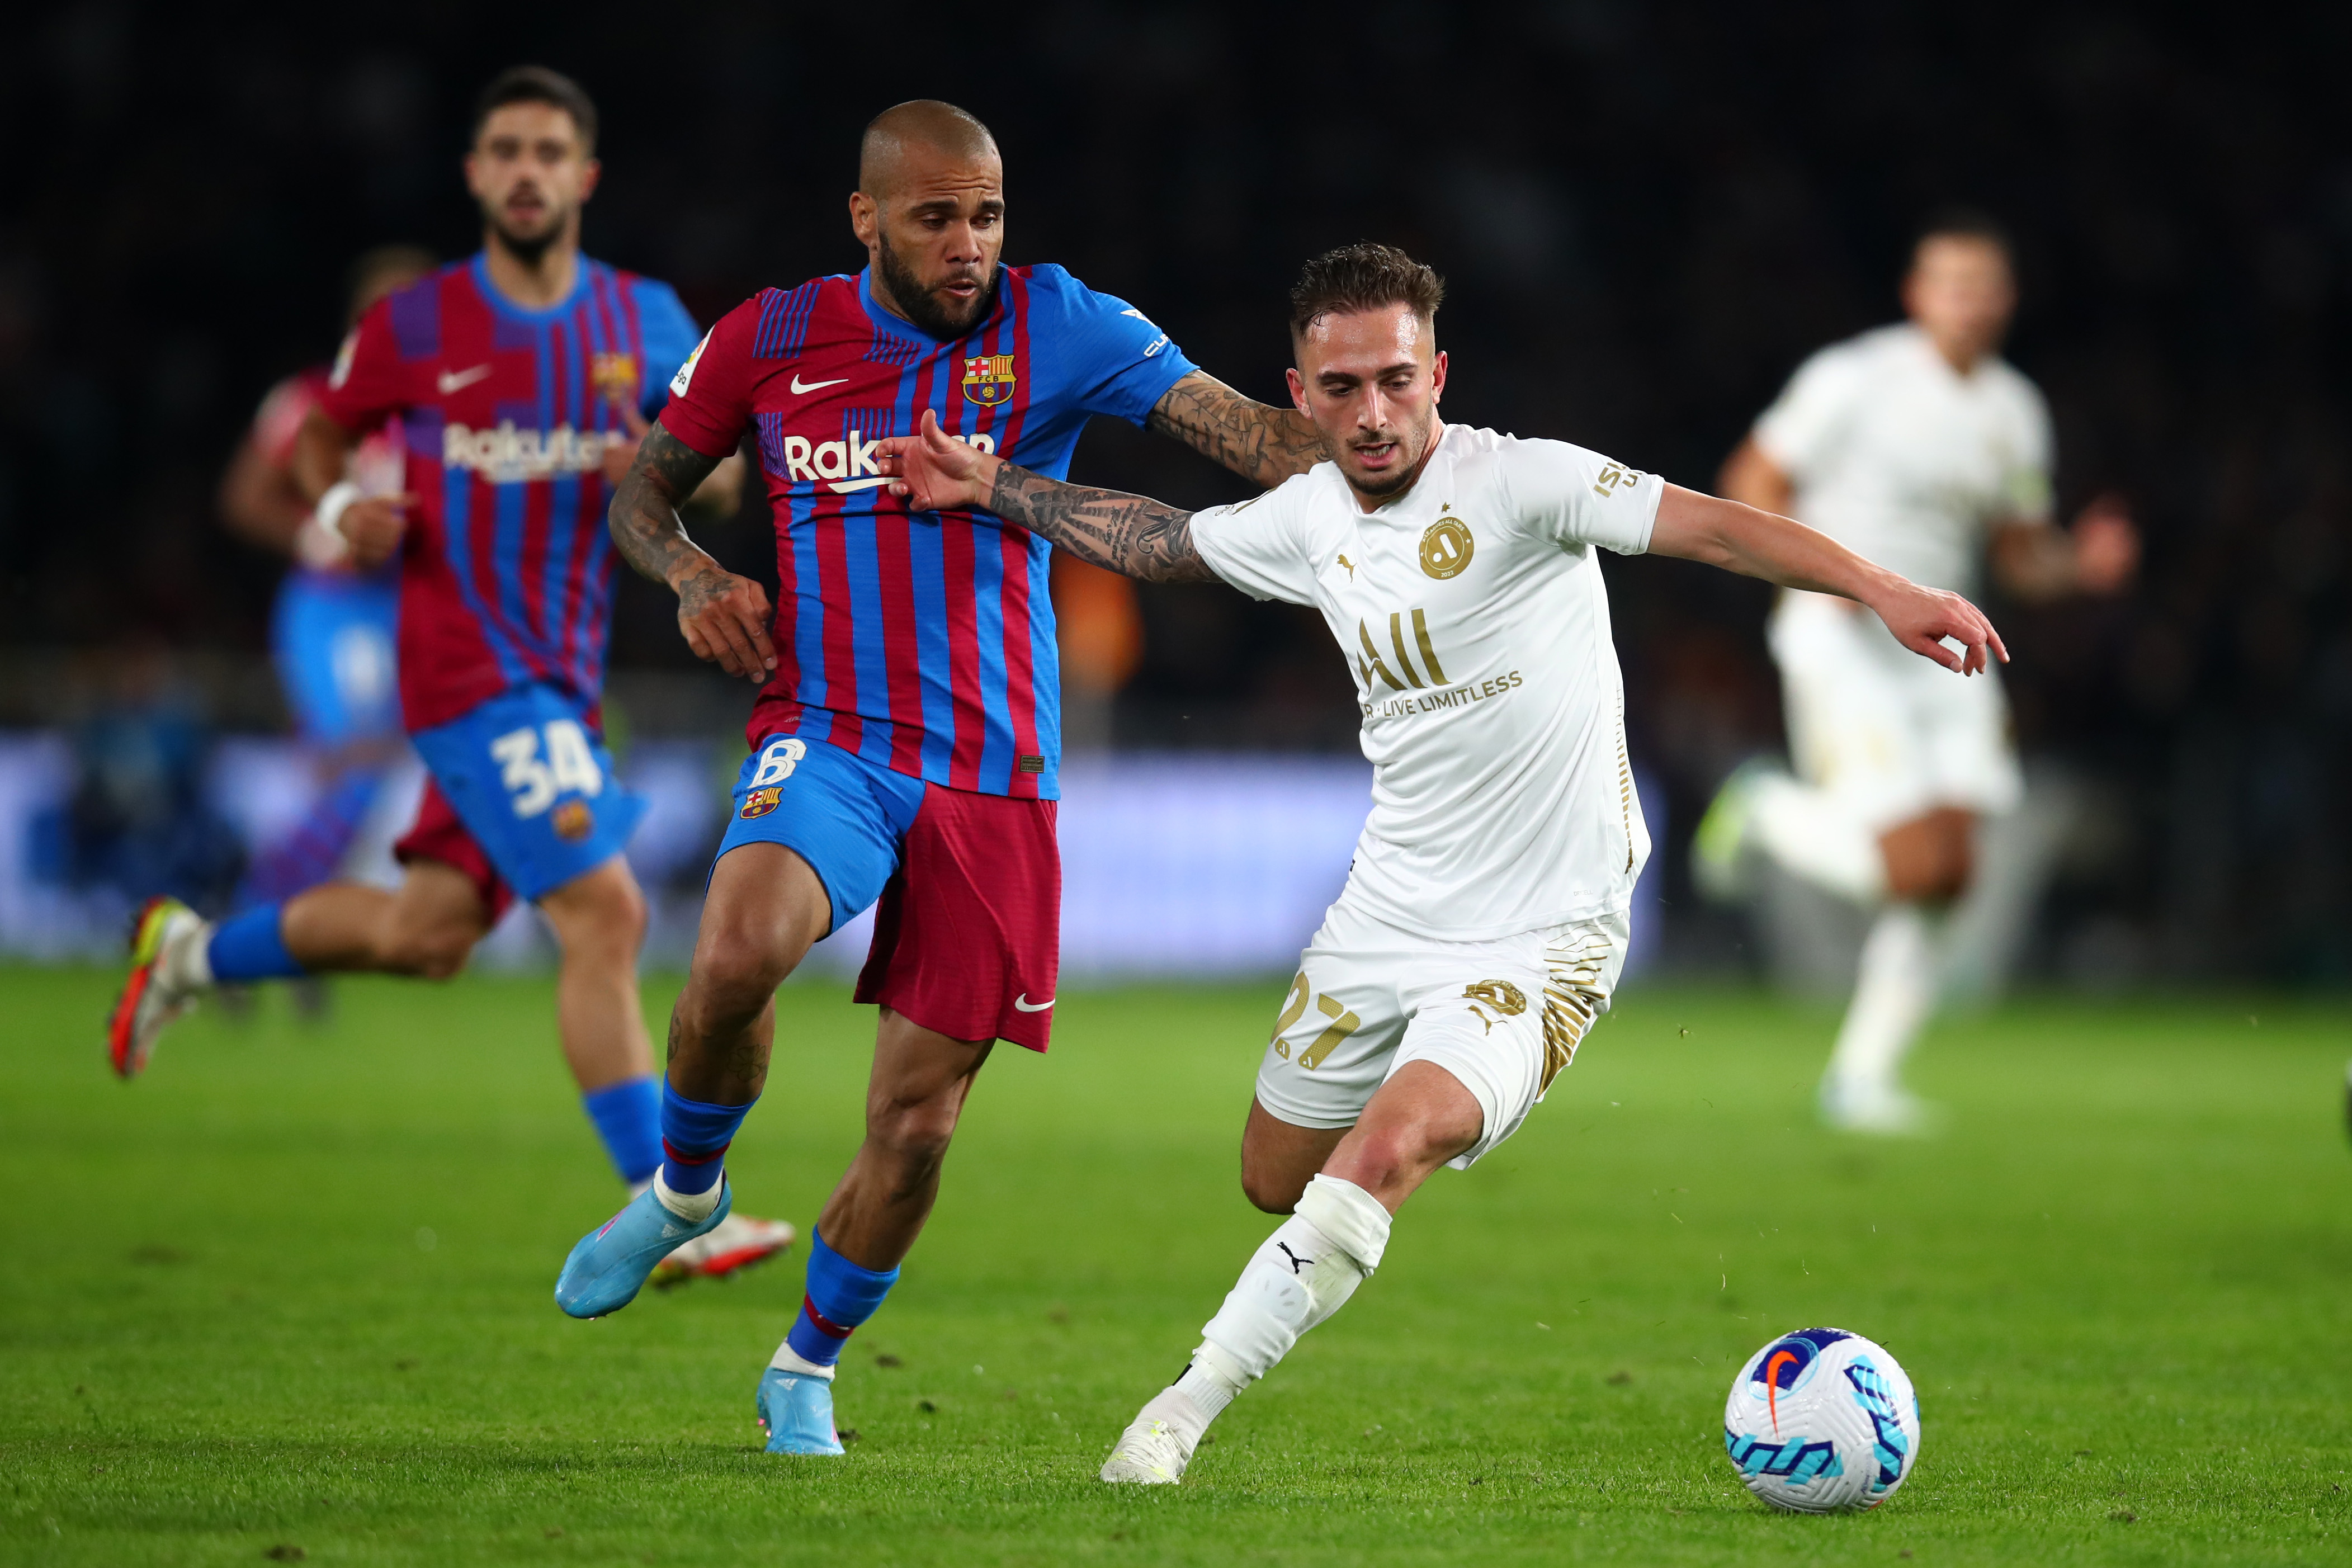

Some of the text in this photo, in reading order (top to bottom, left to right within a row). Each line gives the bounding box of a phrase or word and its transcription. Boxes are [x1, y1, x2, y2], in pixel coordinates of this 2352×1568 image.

[784, 430, 995, 482] Rakn
[1383, 700, 1416, 717] LIVE
[1418, 670, 1523, 712] LIMITLESS
[491, 719, 603, 819] 34
[1270, 970, 1361, 1071] 27
